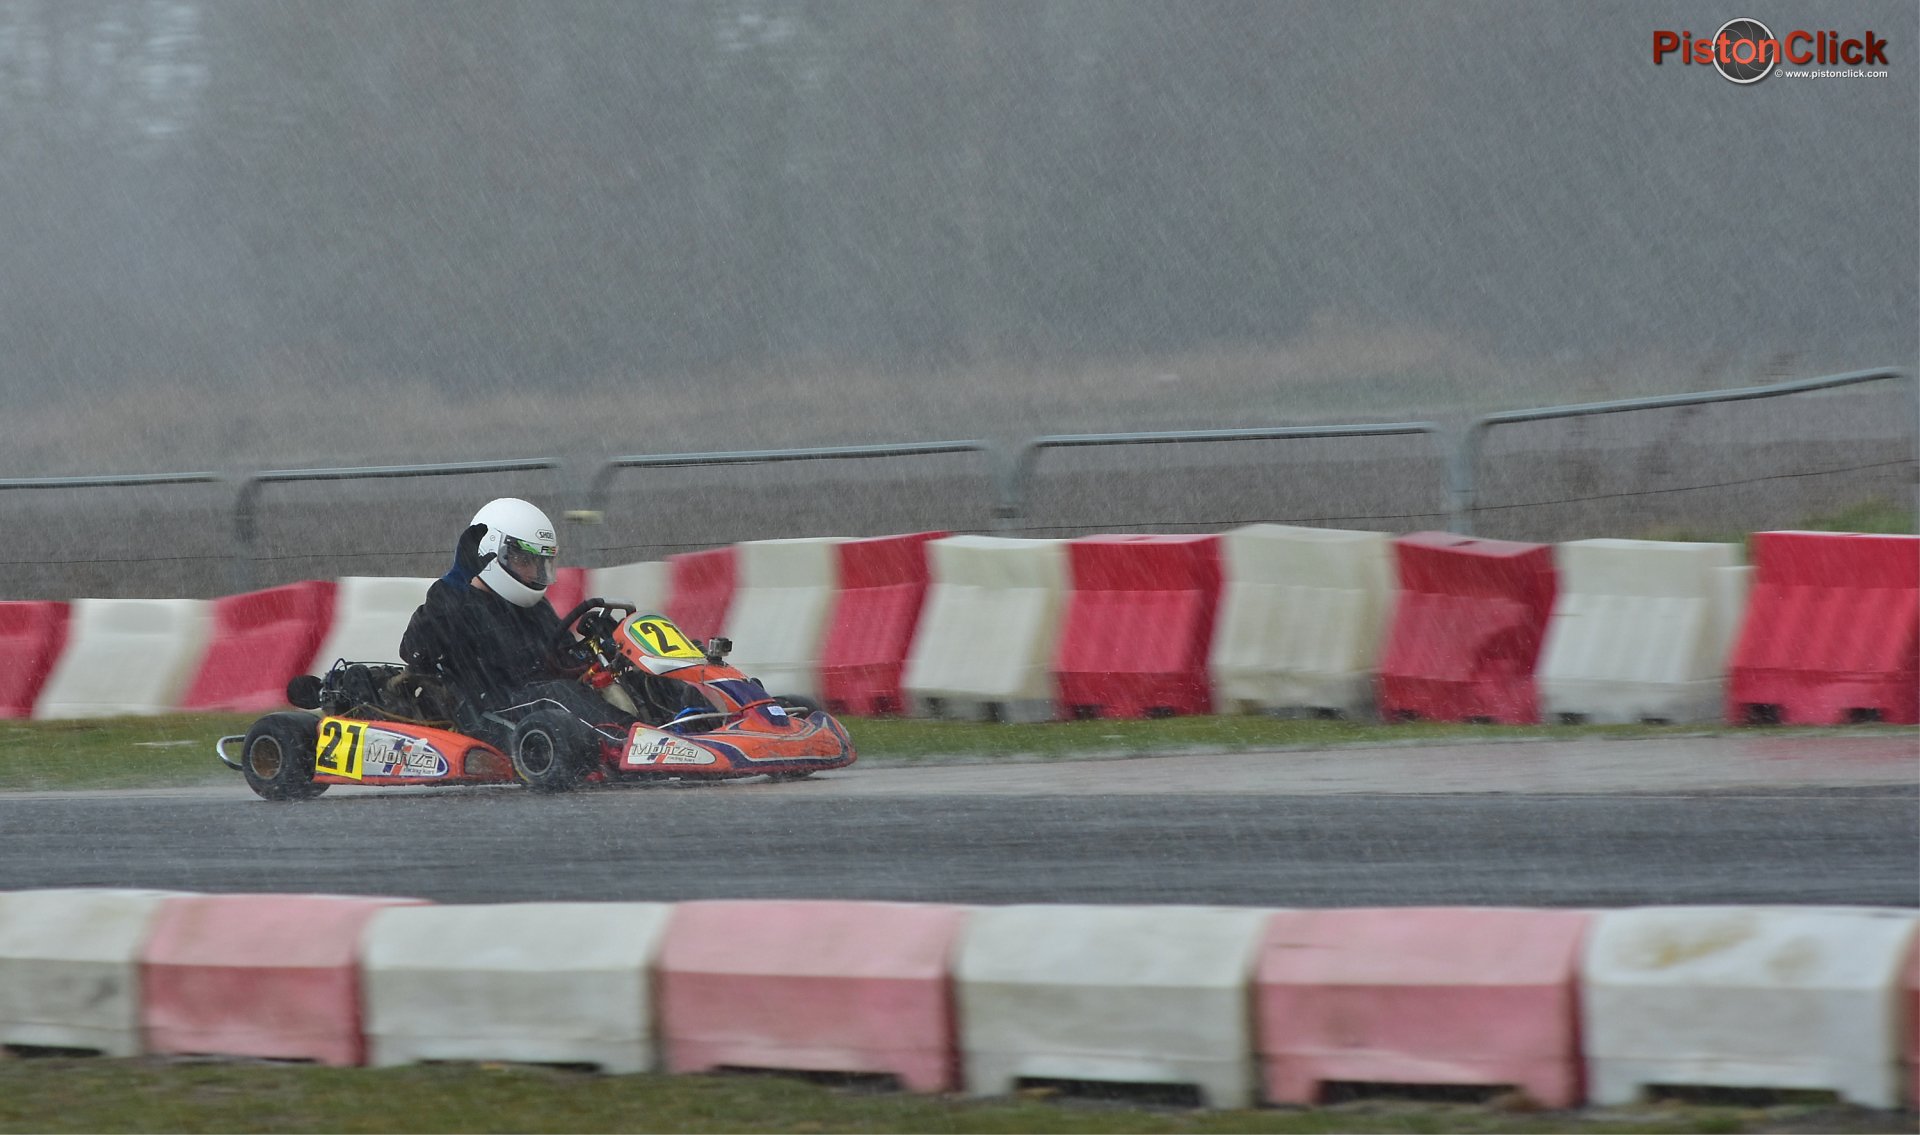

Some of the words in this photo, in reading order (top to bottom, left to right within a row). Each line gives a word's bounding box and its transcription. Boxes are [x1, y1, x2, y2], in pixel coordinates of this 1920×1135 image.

[317, 721, 362, 774] 21
[365, 742, 437, 768] Monza
[630, 742, 699, 758] Monza
